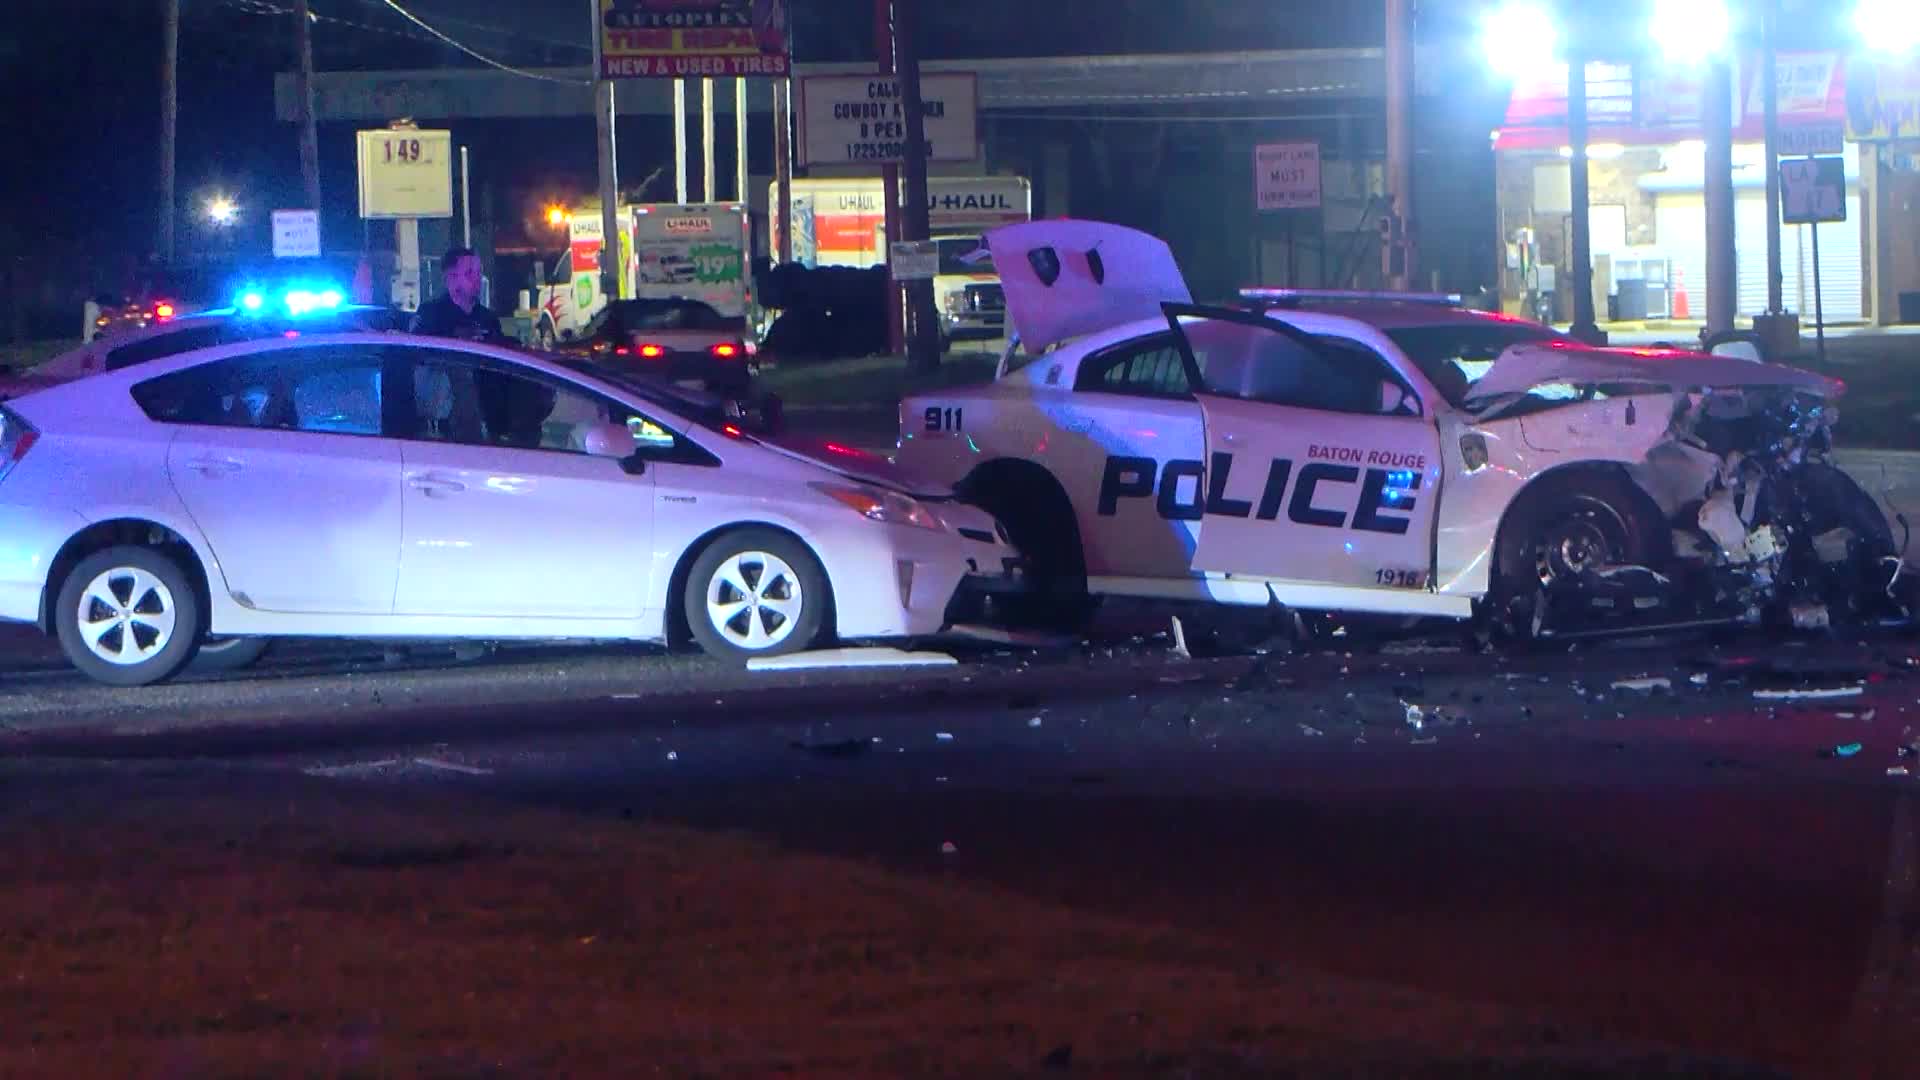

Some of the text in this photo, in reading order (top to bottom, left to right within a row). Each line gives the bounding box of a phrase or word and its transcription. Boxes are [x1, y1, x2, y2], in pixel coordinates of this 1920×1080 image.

[607, 55, 785, 75] NEW & USED TIRES
[834, 103, 887, 119] COWBOY
[1270, 168, 1305, 184] MUST
[839, 195, 875, 210] U-HAUL
[666, 217, 711, 228] U-HAUL
[925, 407, 963, 432] 911
[1307, 443, 1425, 469] BATON ROUGE
[1097, 450, 1423, 535] POLICE
